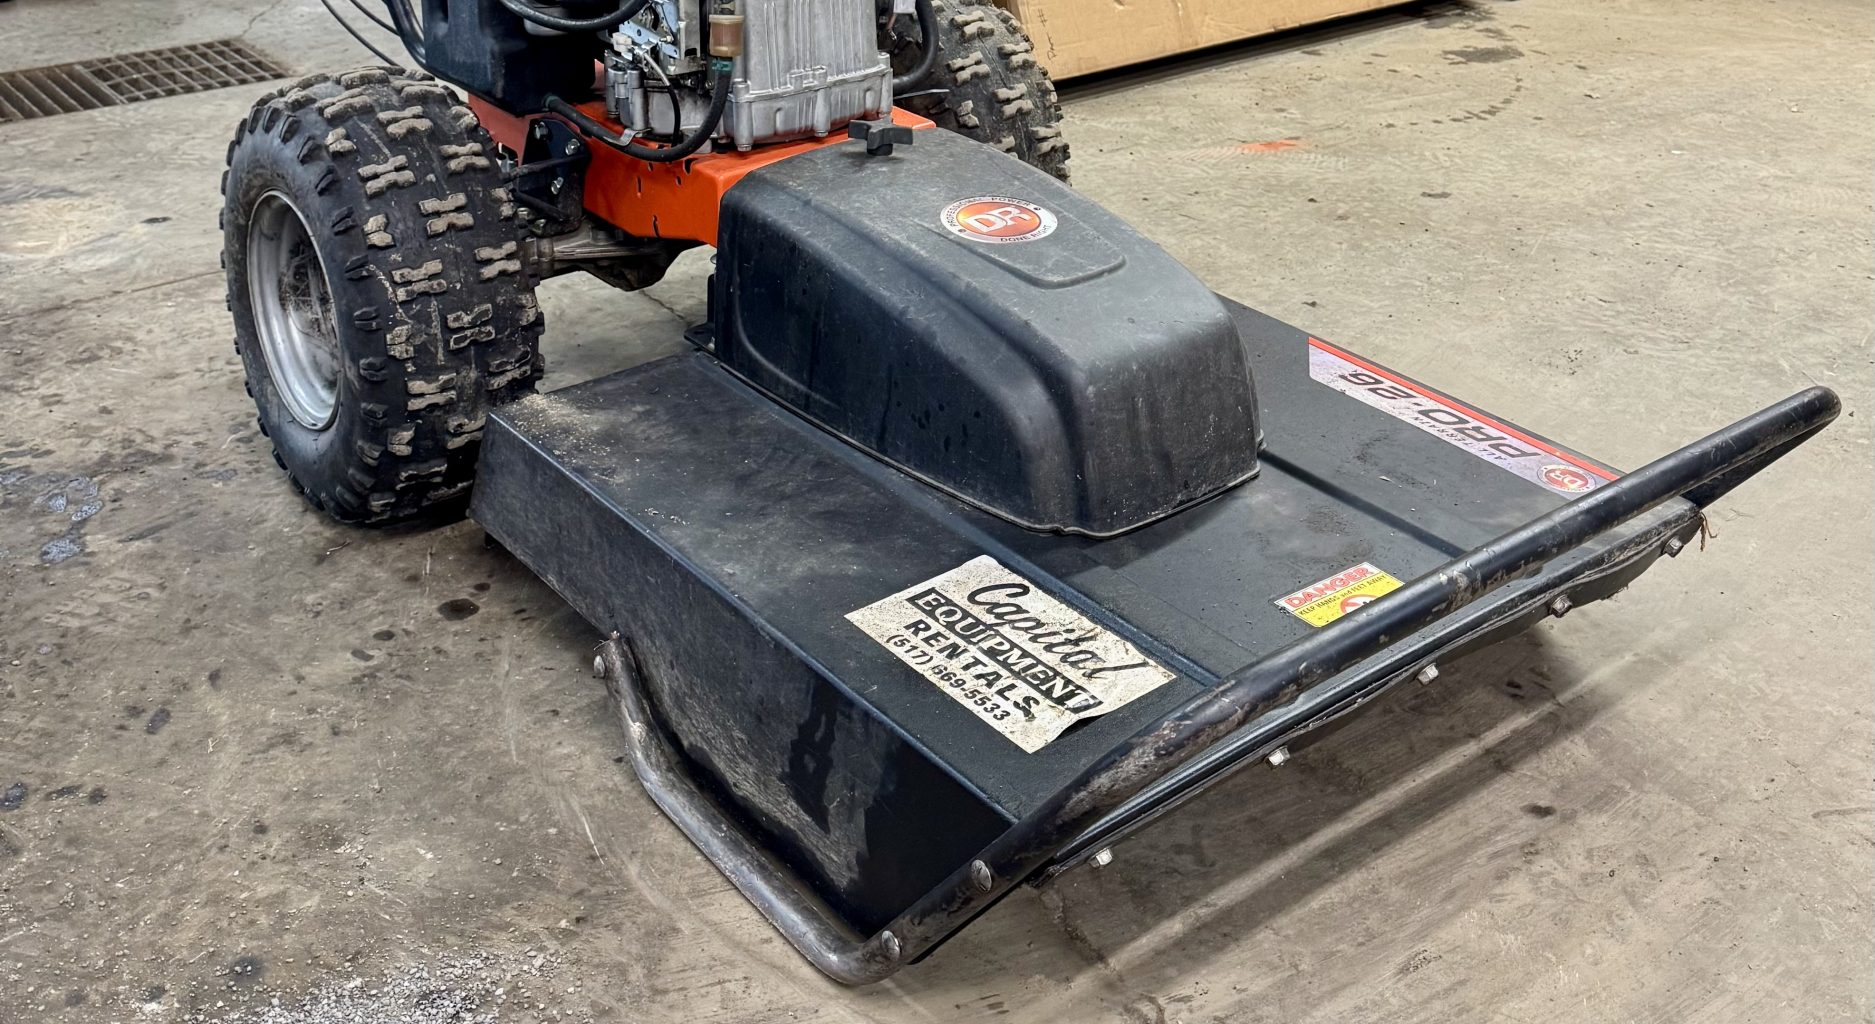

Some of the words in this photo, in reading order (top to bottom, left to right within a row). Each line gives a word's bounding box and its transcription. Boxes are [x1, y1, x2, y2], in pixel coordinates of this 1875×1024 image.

[963, 206, 1033, 233] DR
[990, 196, 1031, 207] POWER
[1000, 235, 1031, 243] DONE
[1548, 470, 1588, 488] DR
[1284, 566, 1373, 608] DANGER
[1299, 604, 1316, 616] KEEP
[1367, 574, 1387, 586] AWAY
[917, 588, 1097, 710] EQUIPMENT
[966, 582, 1149, 680] Capital
[886, 634, 934, 665] (517)
[931, 664, 1011, 721] 669-5533
[904, 619, 1040, 719] RENTALS
